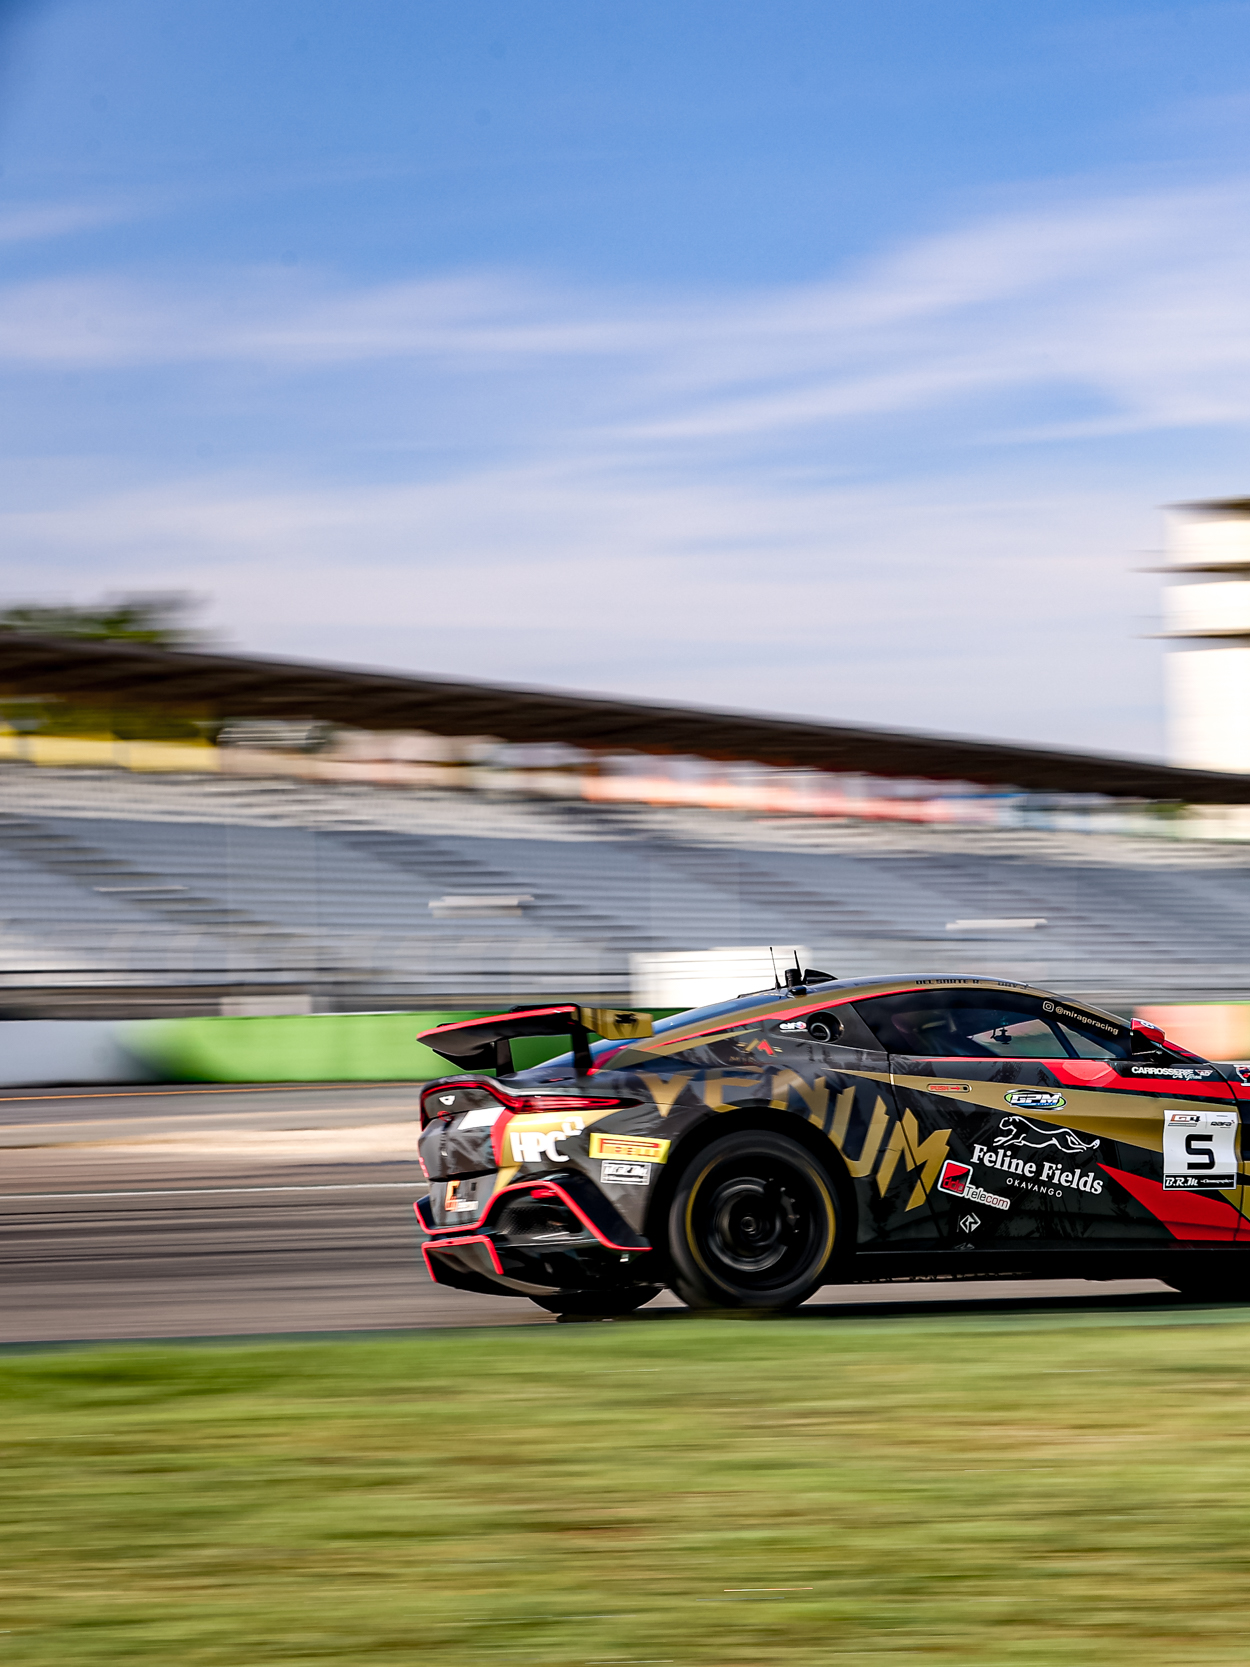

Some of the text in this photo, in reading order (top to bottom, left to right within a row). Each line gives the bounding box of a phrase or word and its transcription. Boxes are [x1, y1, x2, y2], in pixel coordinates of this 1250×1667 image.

[1055, 1006, 1119, 1036] @mirageracing
[1010, 1093, 1060, 1104] GPM
[635, 1064, 953, 1212] VENUM
[1185, 1133, 1215, 1170] 5
[970, 1143, 1104, 1195] Feline Fields
[966, 1185, 1010, 1209] Telecom
[1006, 1177, 1063, 1198] OKAVANGO
